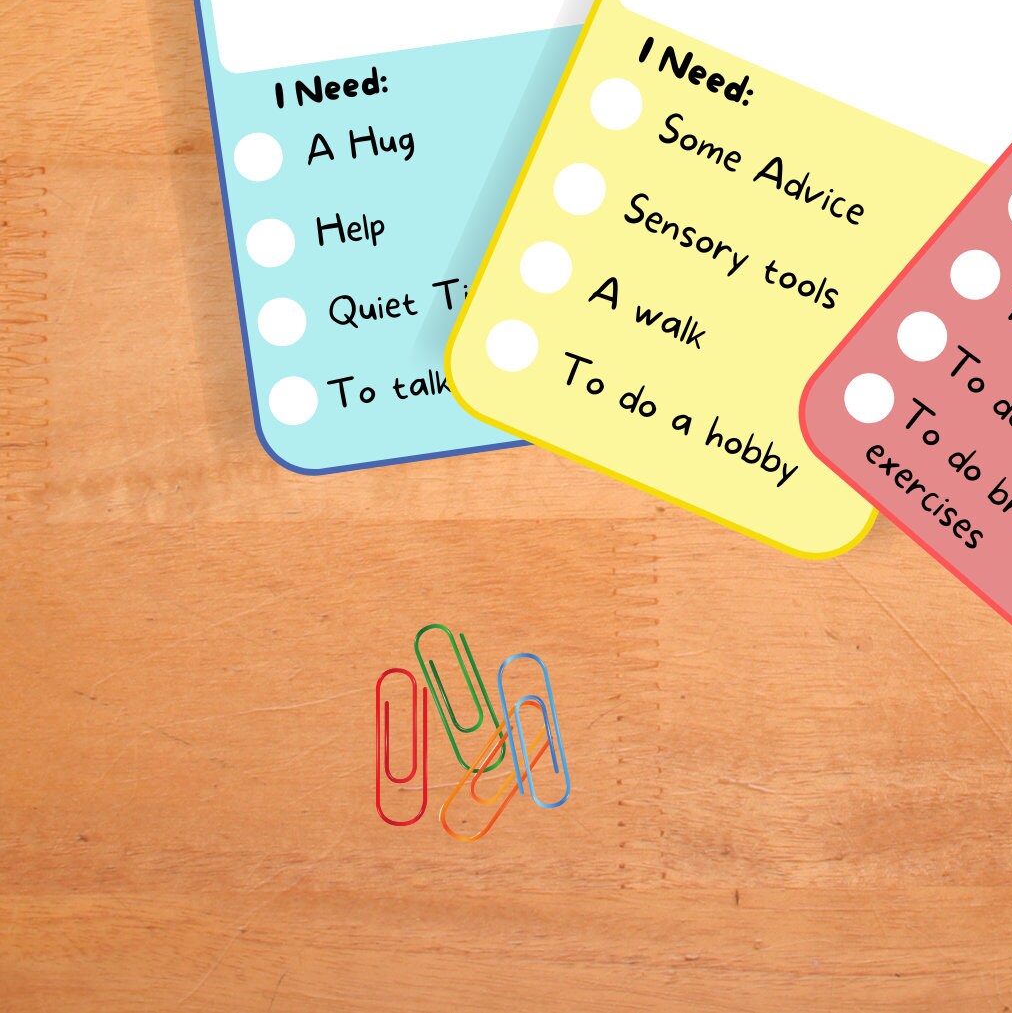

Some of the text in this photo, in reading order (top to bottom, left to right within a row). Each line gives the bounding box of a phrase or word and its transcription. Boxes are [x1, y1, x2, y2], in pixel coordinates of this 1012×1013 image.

[274, 66, 388, 109] I Need:
[637, 35, 754, 107] I Need:
[306, 125, 415, 166] A Hug
[658, 113, 865, 225] Some Advice
[315, 212, 385, 247] Help
[623, 193, 839, 309] Sensory tools
[328, 293, 418, 329] Quiet
[588, 275, 706, 350] A walk
[326, 369, 451, 408] To talk
[949, 345, 985, 394] To
[564, 351, 799, 488] To do a hobby
[905, 397, 940, 447] To
[947, 450, 981, 482] do
[865, 444, 984, 550] exercises
